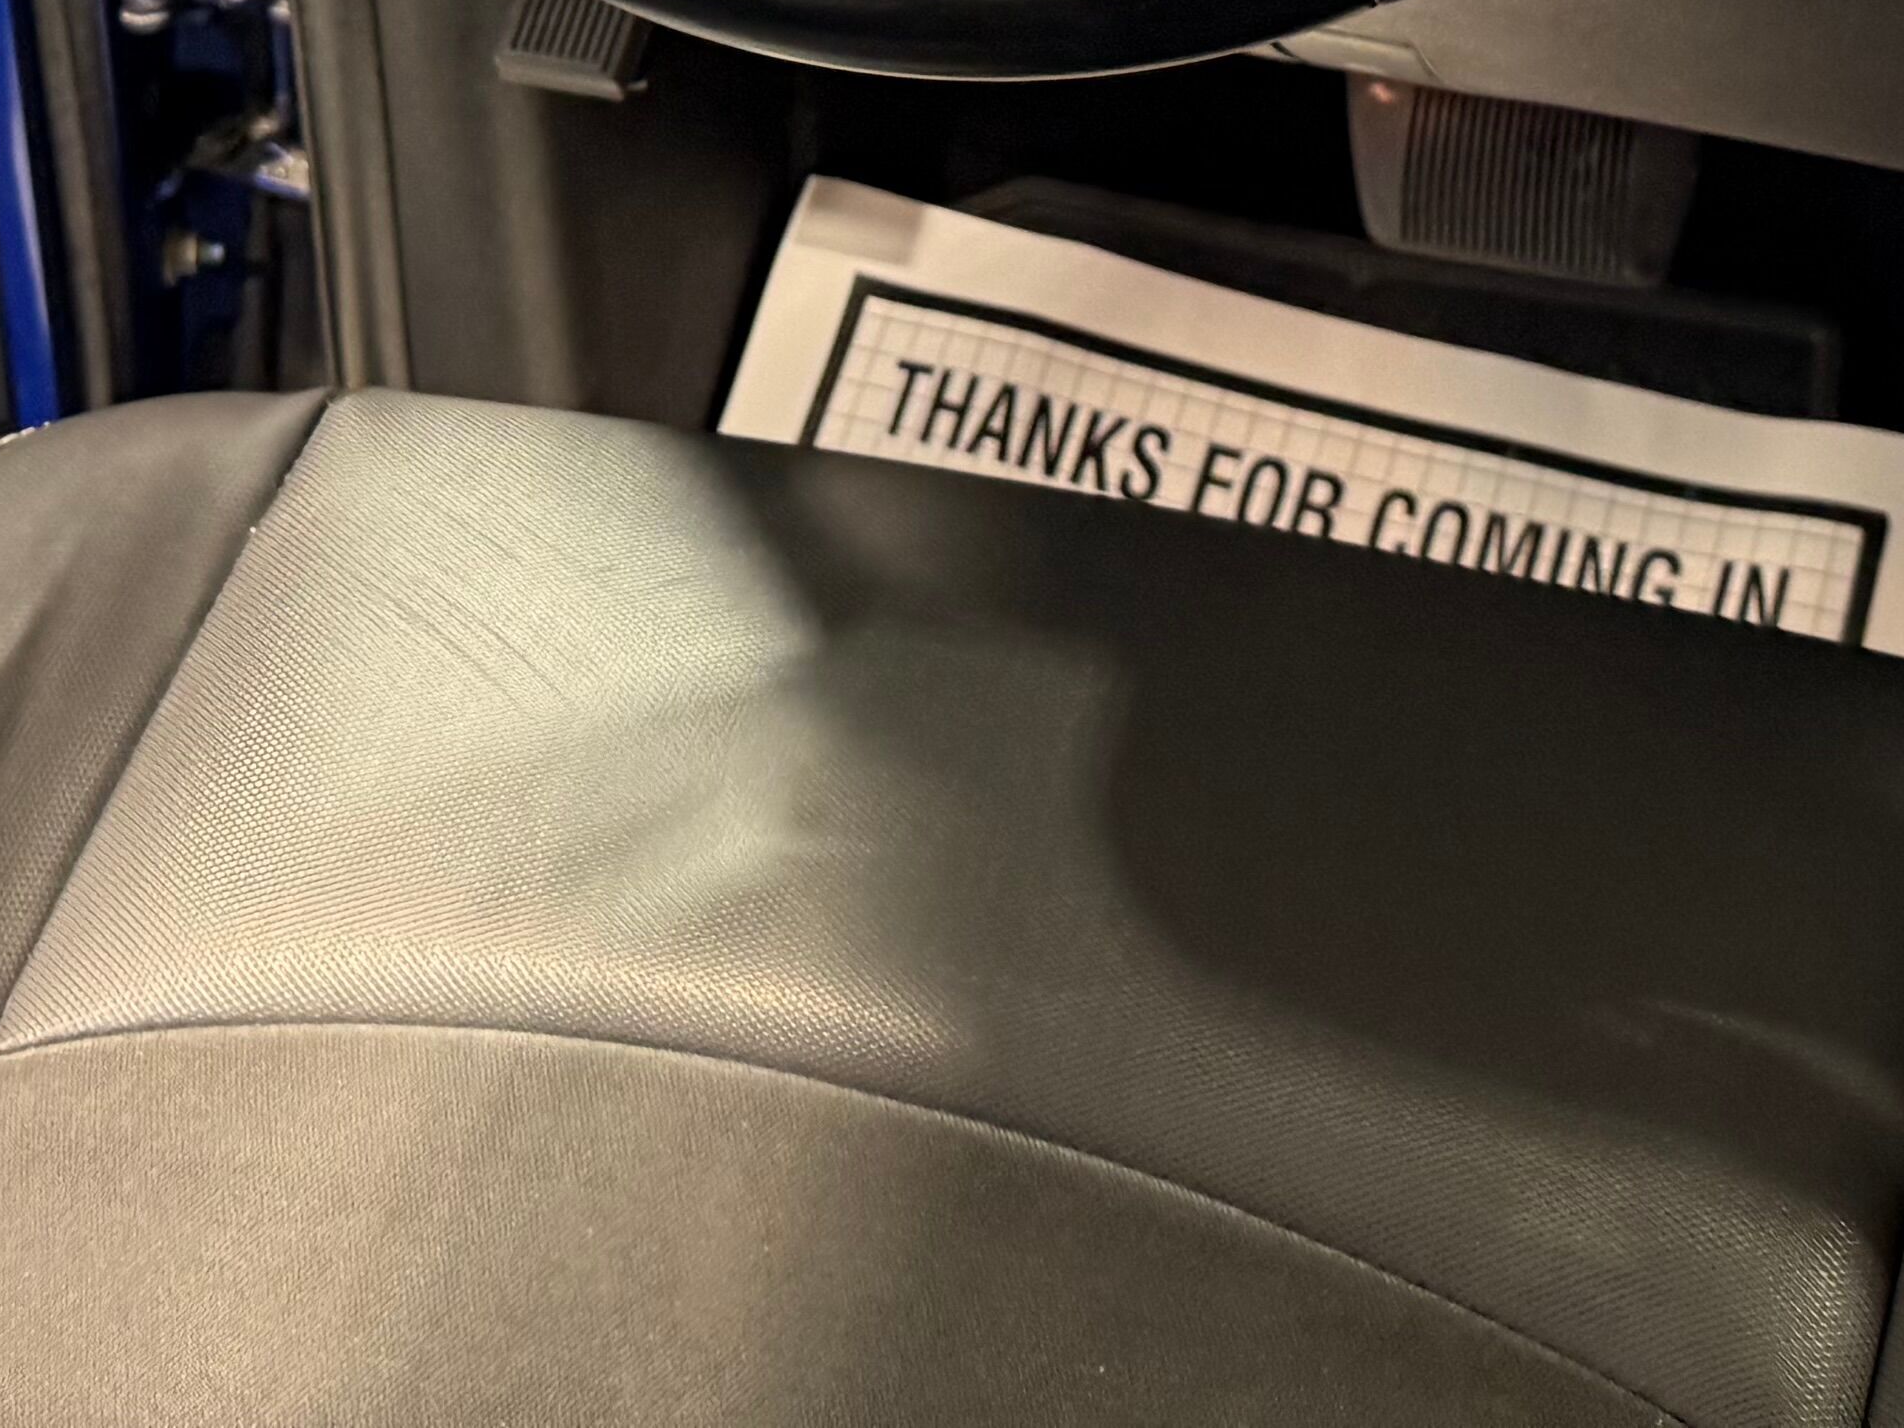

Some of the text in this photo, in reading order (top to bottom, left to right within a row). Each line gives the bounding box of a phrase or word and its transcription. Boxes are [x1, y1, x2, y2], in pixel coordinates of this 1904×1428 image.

[888, 359, 1790, 629] THANKS FOR COMING IN
